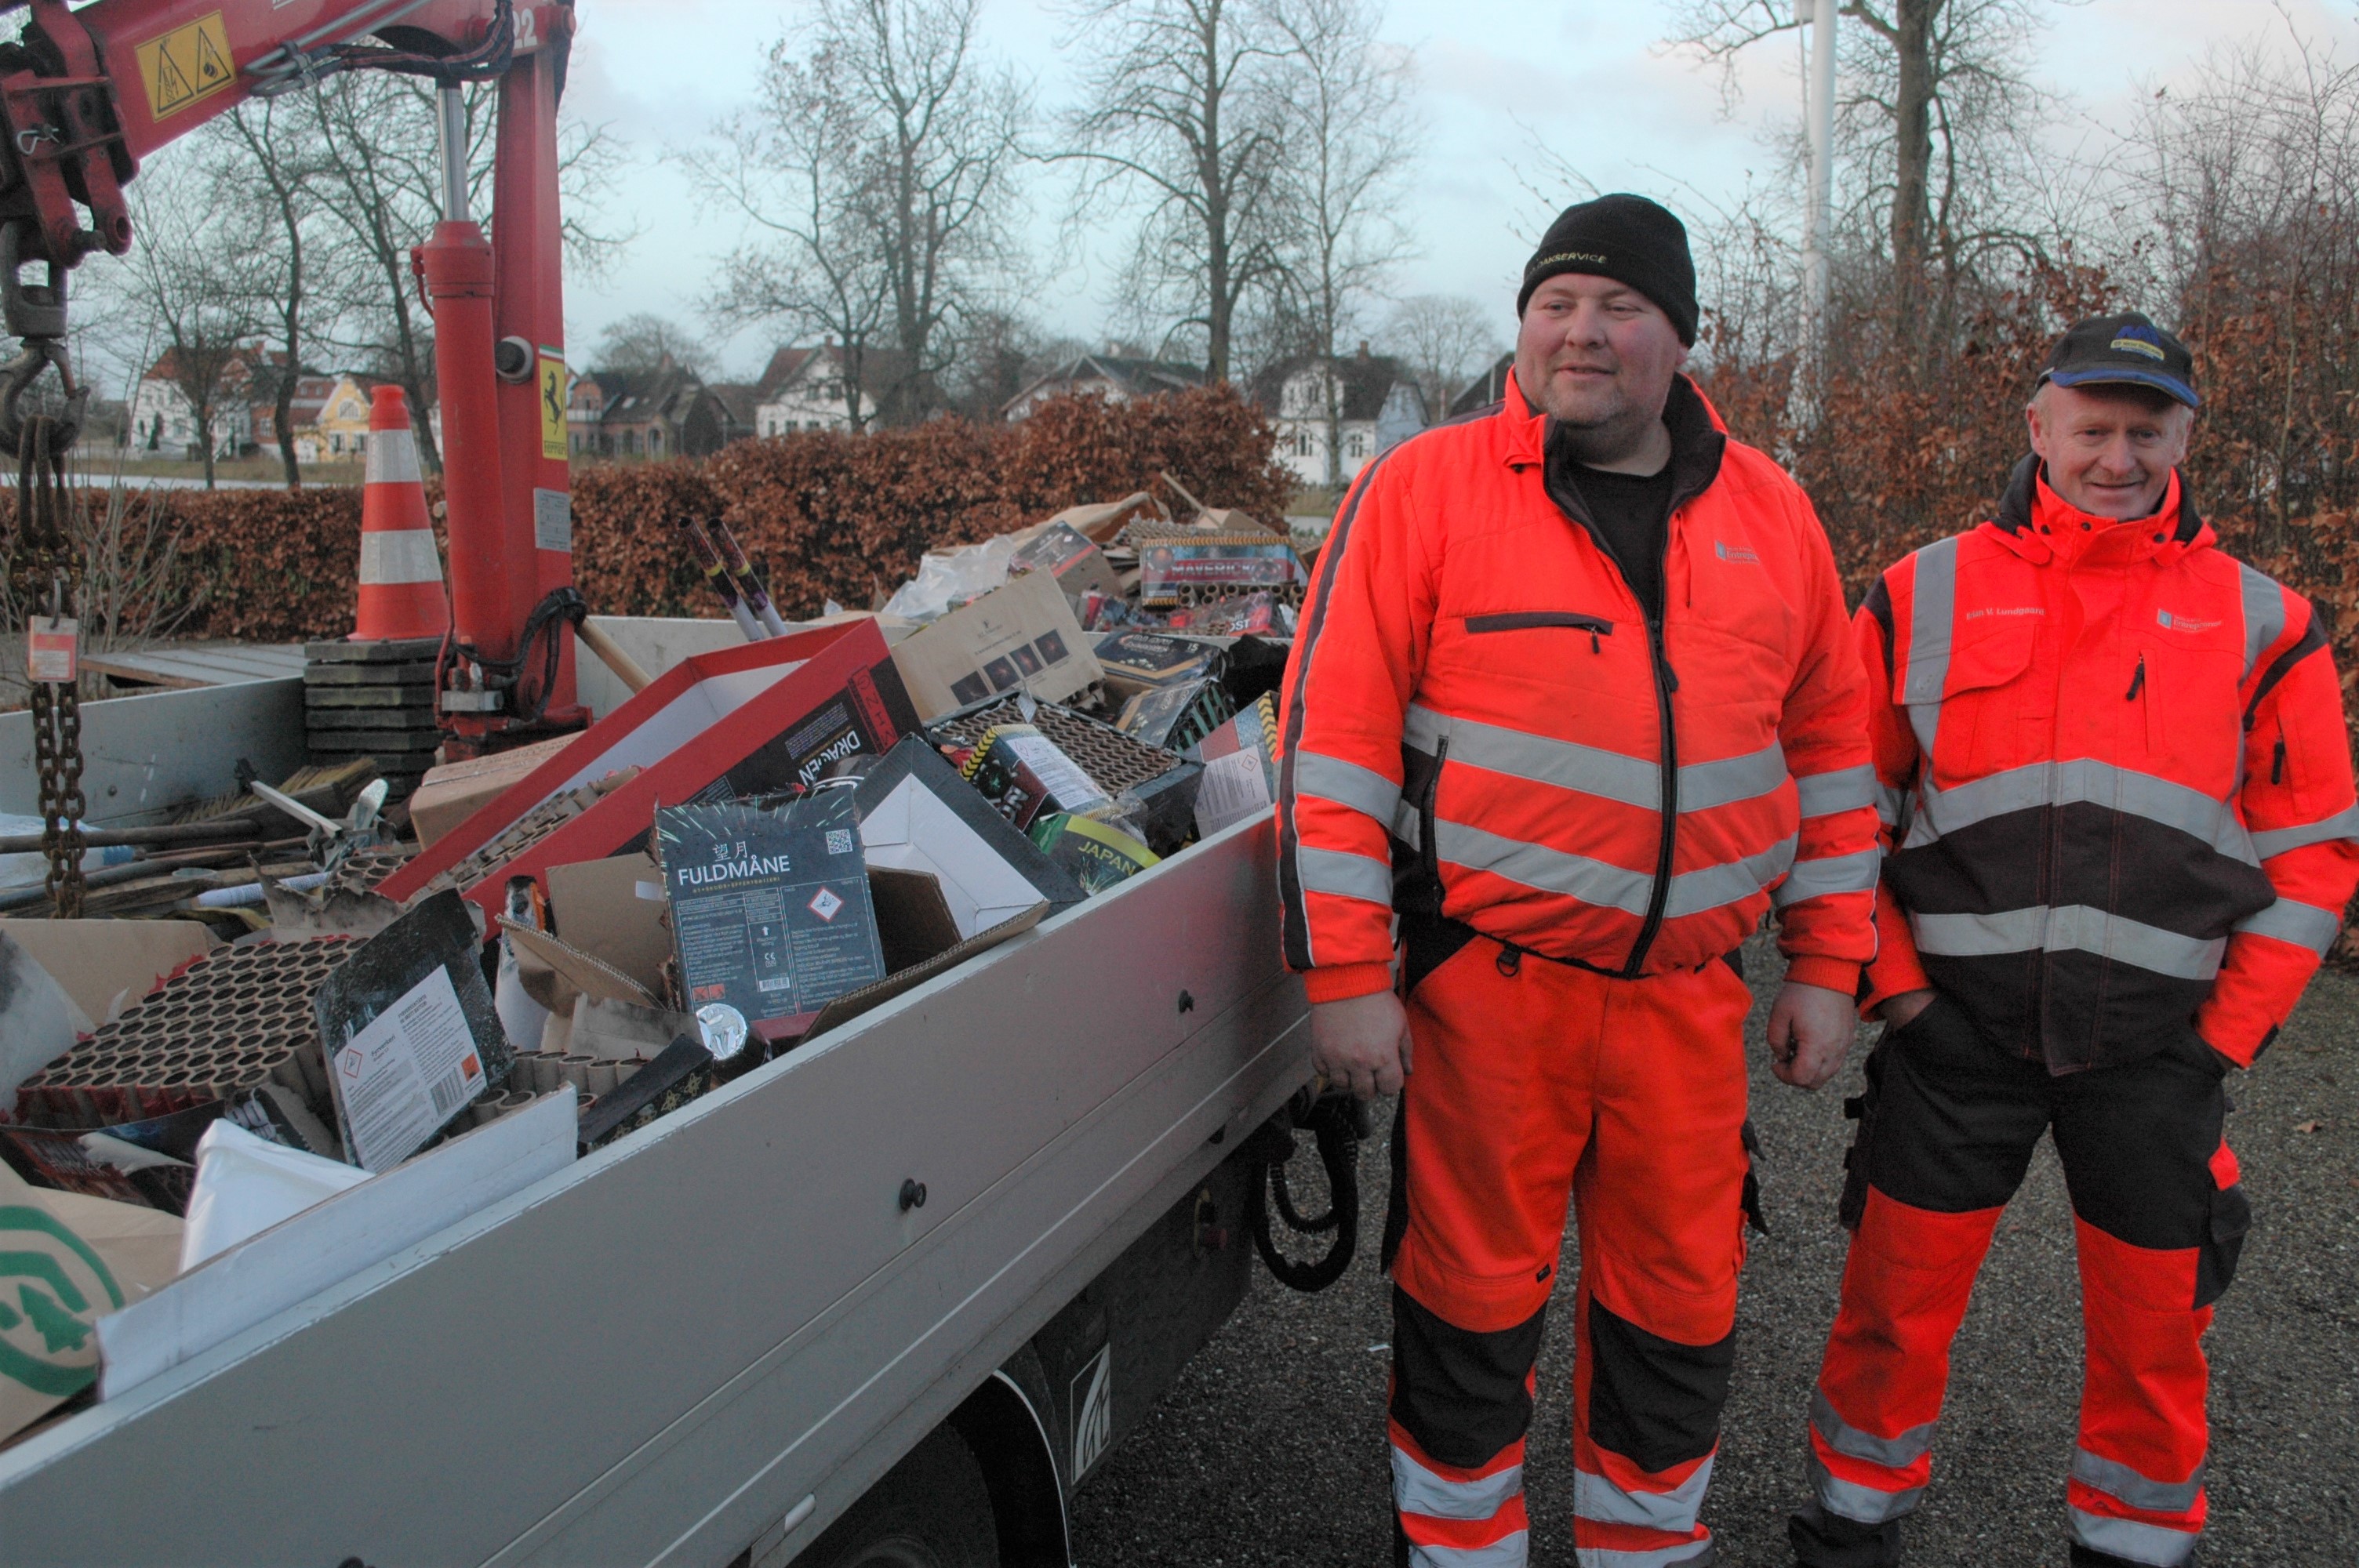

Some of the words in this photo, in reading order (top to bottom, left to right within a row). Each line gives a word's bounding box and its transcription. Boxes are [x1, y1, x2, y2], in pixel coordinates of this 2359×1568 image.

[1172, 561, 1256, 576] MAVERICK
[712, 840, 748, 862] 望月
[1078, 840, 1136, 877] JAPAN
[678, 855, 791, 886] FULDMÅNE
